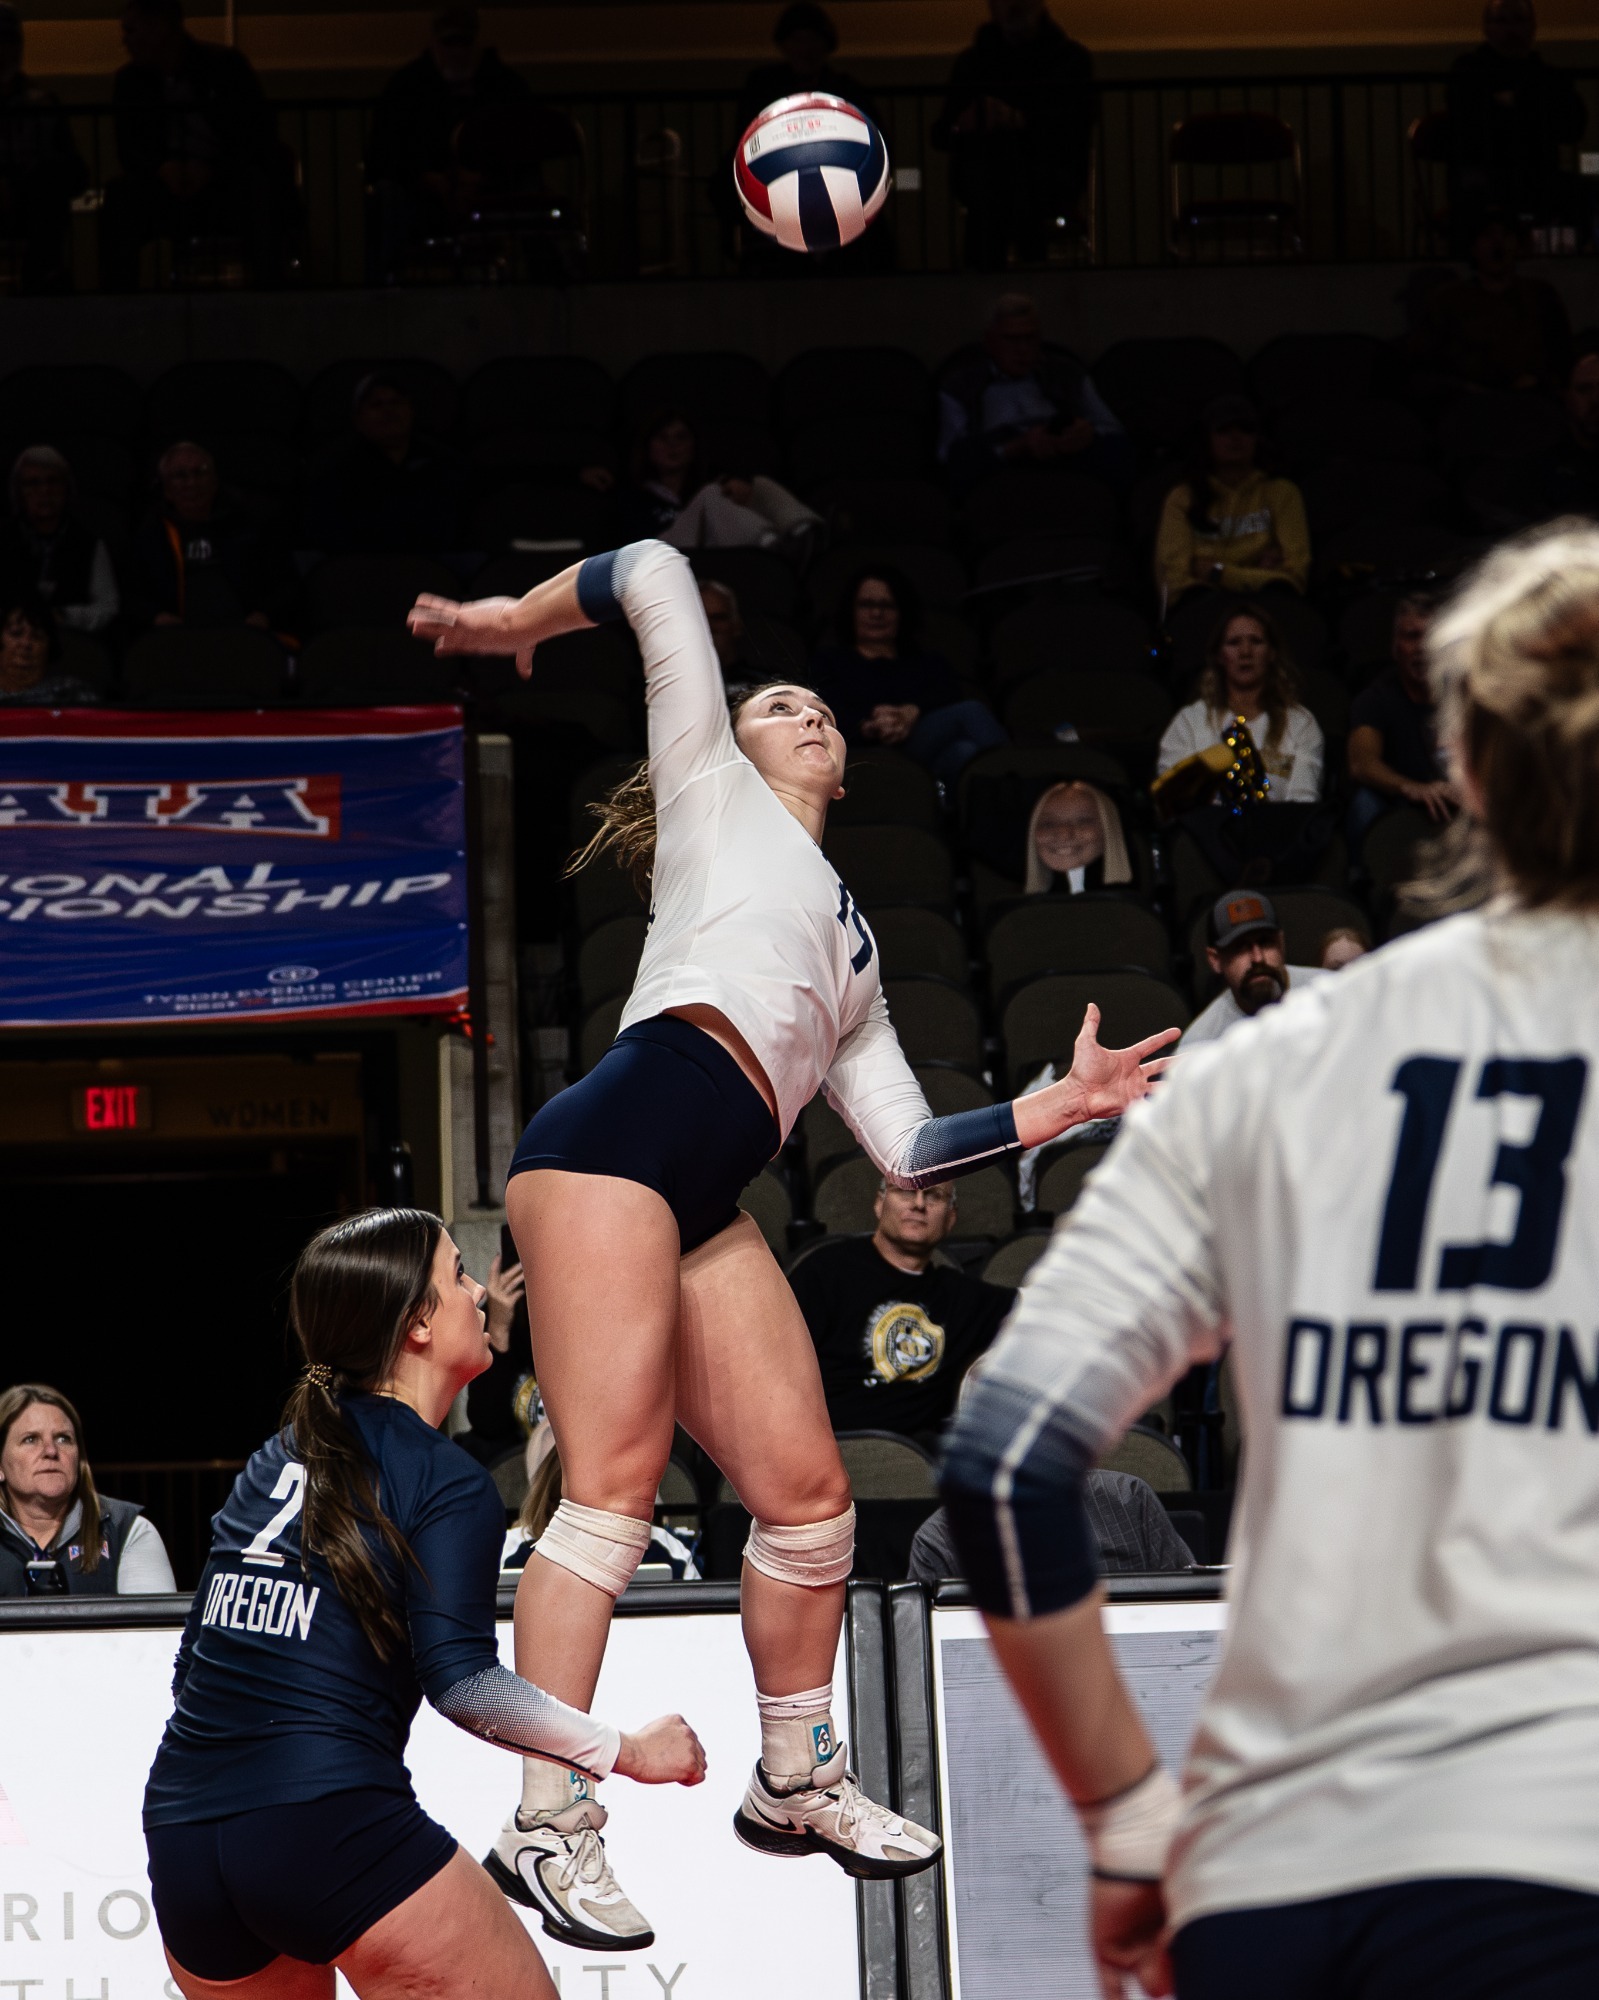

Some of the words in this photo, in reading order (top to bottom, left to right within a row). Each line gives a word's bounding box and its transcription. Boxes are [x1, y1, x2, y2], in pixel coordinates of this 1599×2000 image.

[86, 1085, 138, 1130] EXIT
[208, 1099, 330, 1128] WOMEN
[1373, 1056, 1586, 1290] 13
[1283, 1319, 1599, 1432] OREGON
[240, 1461, 308, 1568] 2
[201, 1572, 320, 1641] OREGON
